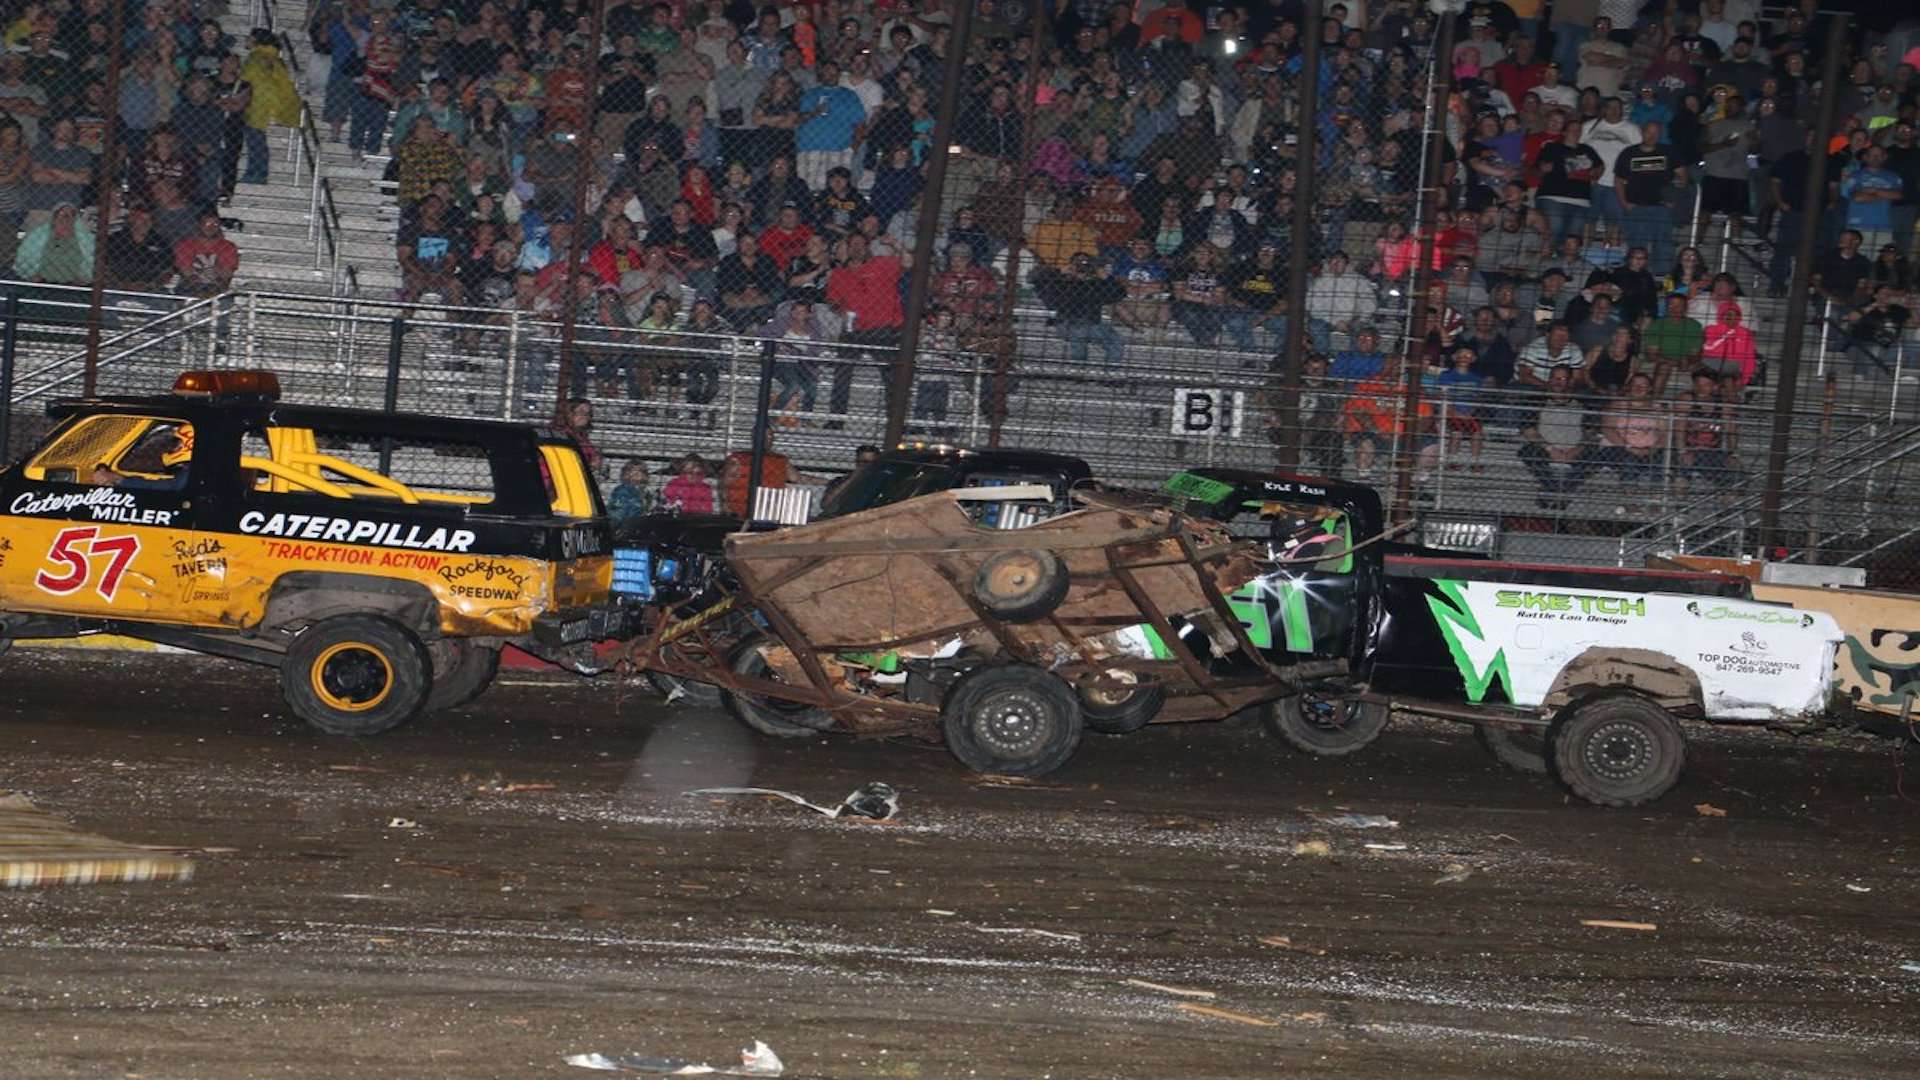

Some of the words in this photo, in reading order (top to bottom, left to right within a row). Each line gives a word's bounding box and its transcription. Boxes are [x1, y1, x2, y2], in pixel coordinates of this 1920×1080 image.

[1183, 392, 1214, 431] B
[10, 487, 136, 514] Caterpillar
[238, 510, 476, 553] CATERPILLAR
[34, 525, 142, 604] 57
[172, 557, 228, 578] TAVERN
[438, 558, 531, 589] Rockford
[450, 584, 521, 602] SPEEDWAY
[1495, 589, 1646, 617] SKETCH
[1698, 653, 1721, 663] TOP
[1723, 654, 1747, 664] DOG
[1748, 659, 1801, 671] AUTOMOTIVE
